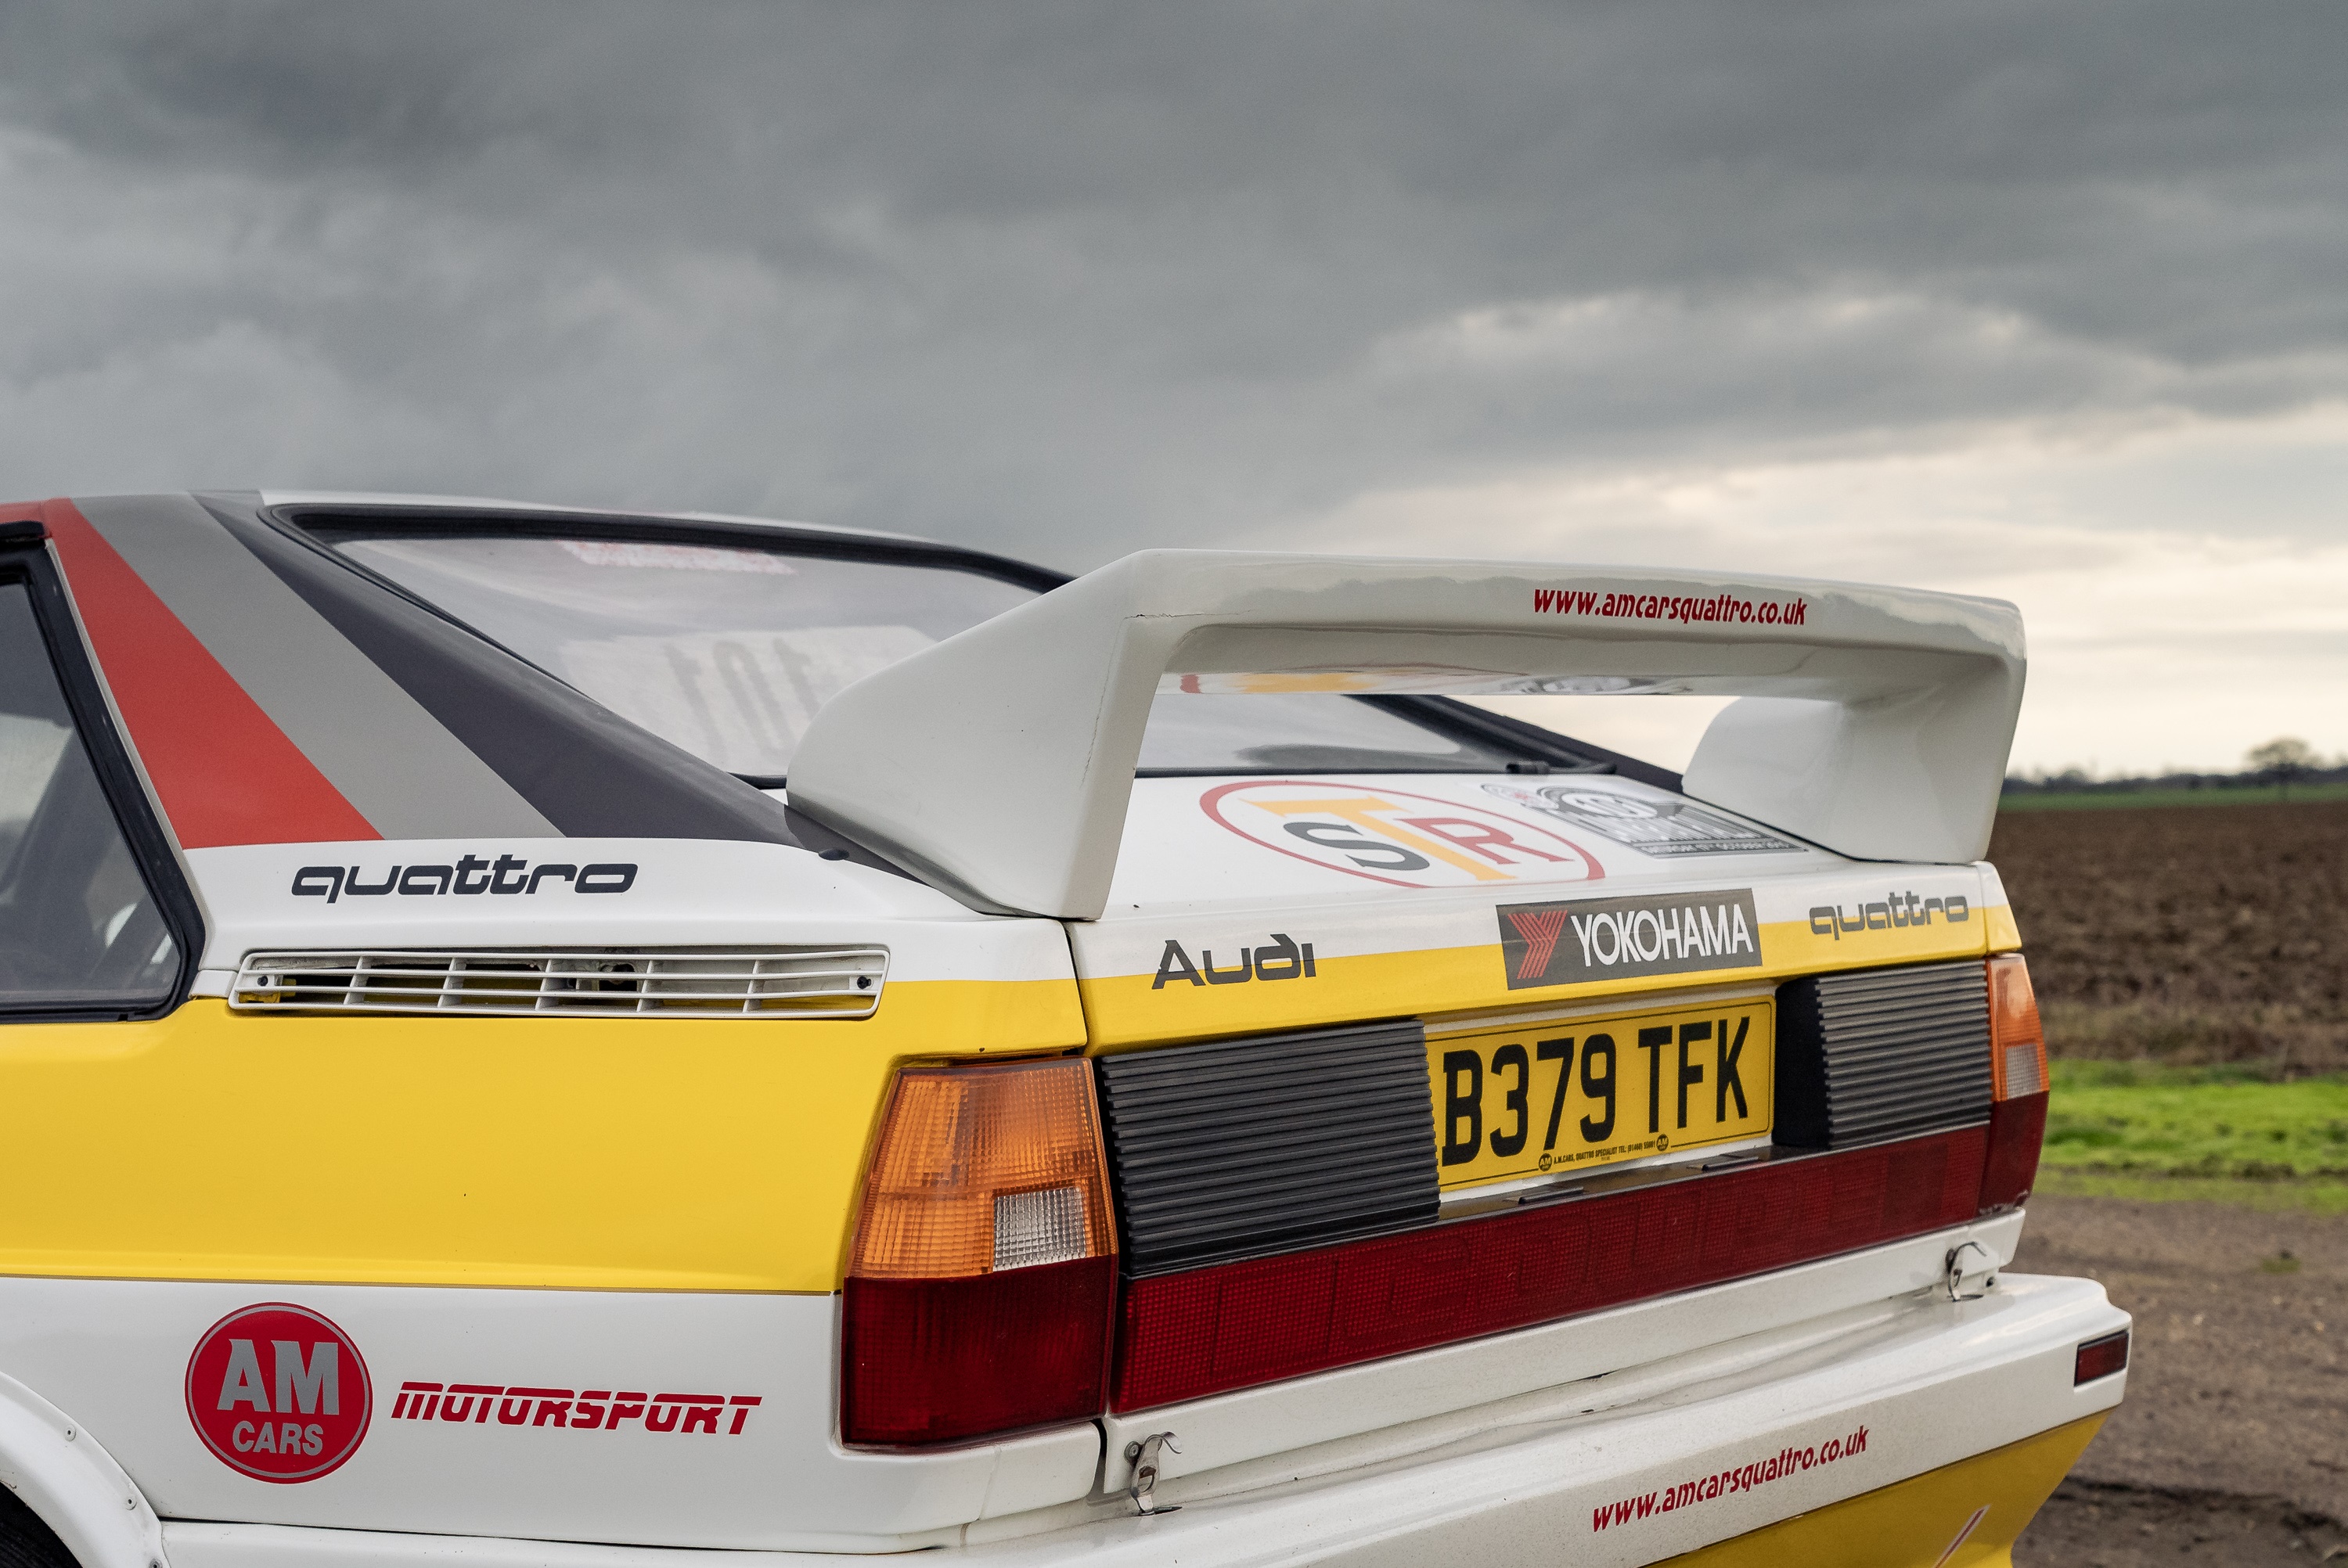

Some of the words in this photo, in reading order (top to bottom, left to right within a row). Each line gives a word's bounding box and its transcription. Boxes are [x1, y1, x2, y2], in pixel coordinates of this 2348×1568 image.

[1533, 588, 1808, 626] www.amcarsquattro.co.uk
[290, 854, 639, 904] quattro
[1570, 903, 1754, 968] YOKOHAMA
[1809, 890, 1969, 941] quattro
[1151, 933, 1316, 990] Audi
[1441, 1033, 1617, 1167] B379
[1637, 1016, 1751, 1134] TFK
[216, 1337, 340, 1416] AM
[391, 1381, 763, 1436] MOTORSPORT
[232, 1420, 324, 1457] CARS
[1593, 1425, 1871, 1533] www.amcarsquattro.co.uk
